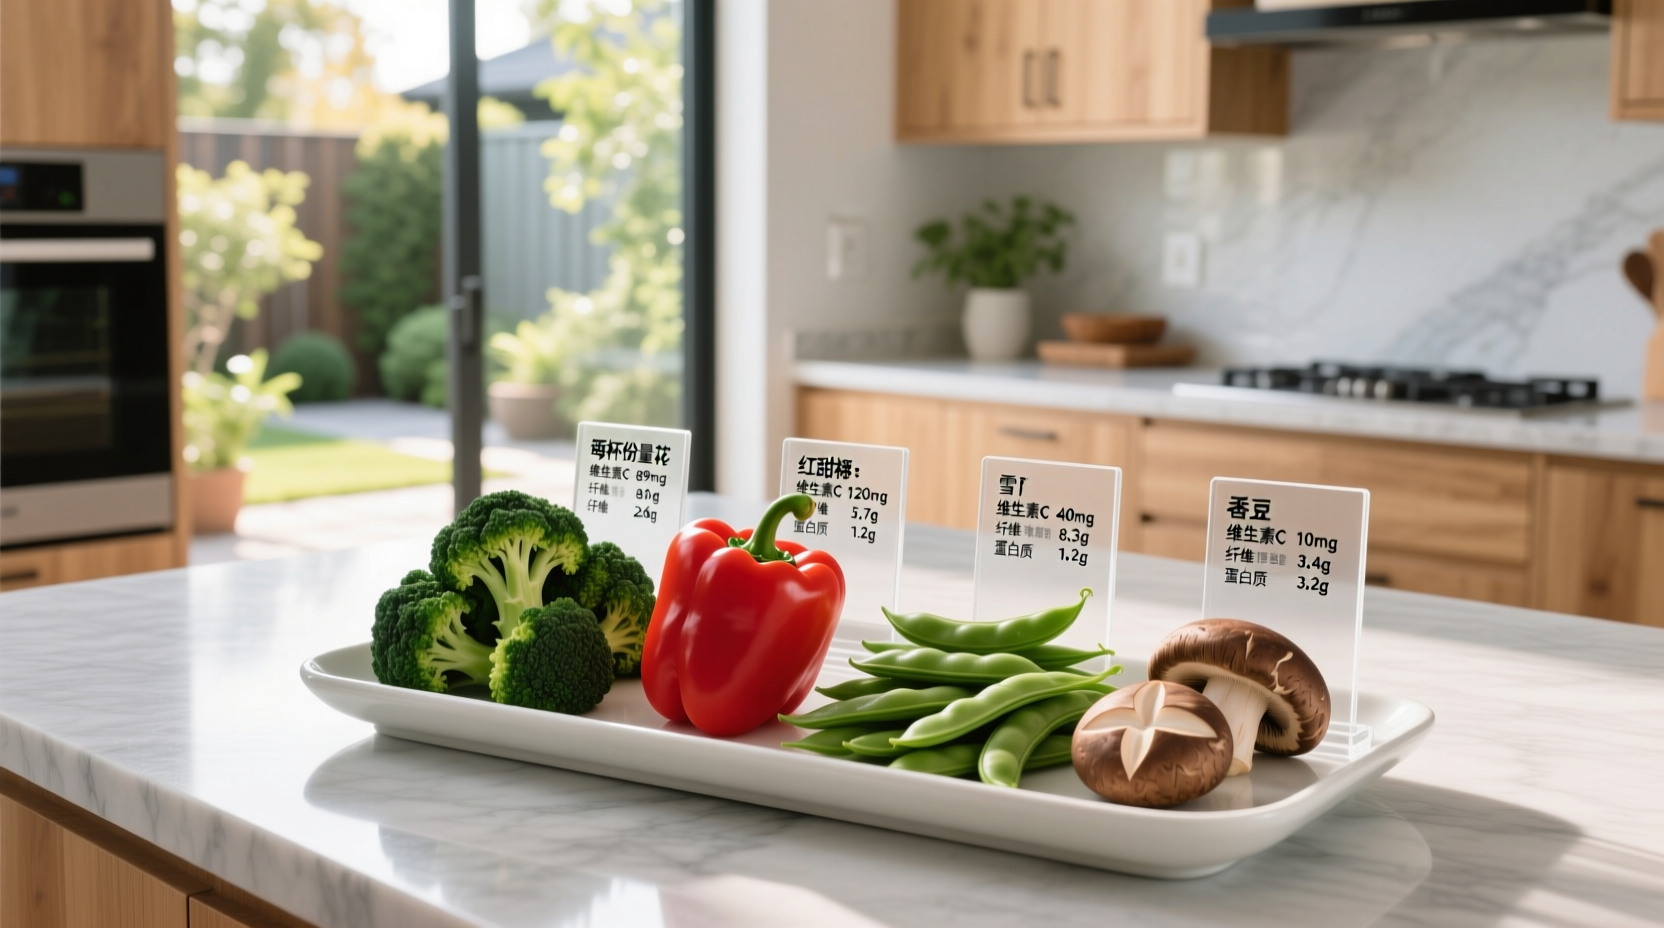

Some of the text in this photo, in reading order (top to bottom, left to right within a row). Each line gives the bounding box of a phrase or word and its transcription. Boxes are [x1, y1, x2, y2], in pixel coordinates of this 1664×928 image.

[850, 506, 879, 525] 5.7g
[995, 499, 1095, 528] 维生素C 40mg
[1226, 495, 1271, 521] 香豆
[851, 526, 876, 544] 1.2g
[995, 520, 1022, 537] 纤维
[1058, 528, 1090, 547] 8.3g
[1225, 523, 1338, 554] 维生素C 10mg
[1058, 547, 1089, 567] 1.2g
[1225, 545, 1255, 563] 纤维
[1297, 554, 1331, 575] 3.4g
[1224, 566, 1330, 596] 蛋白质 3.2g
